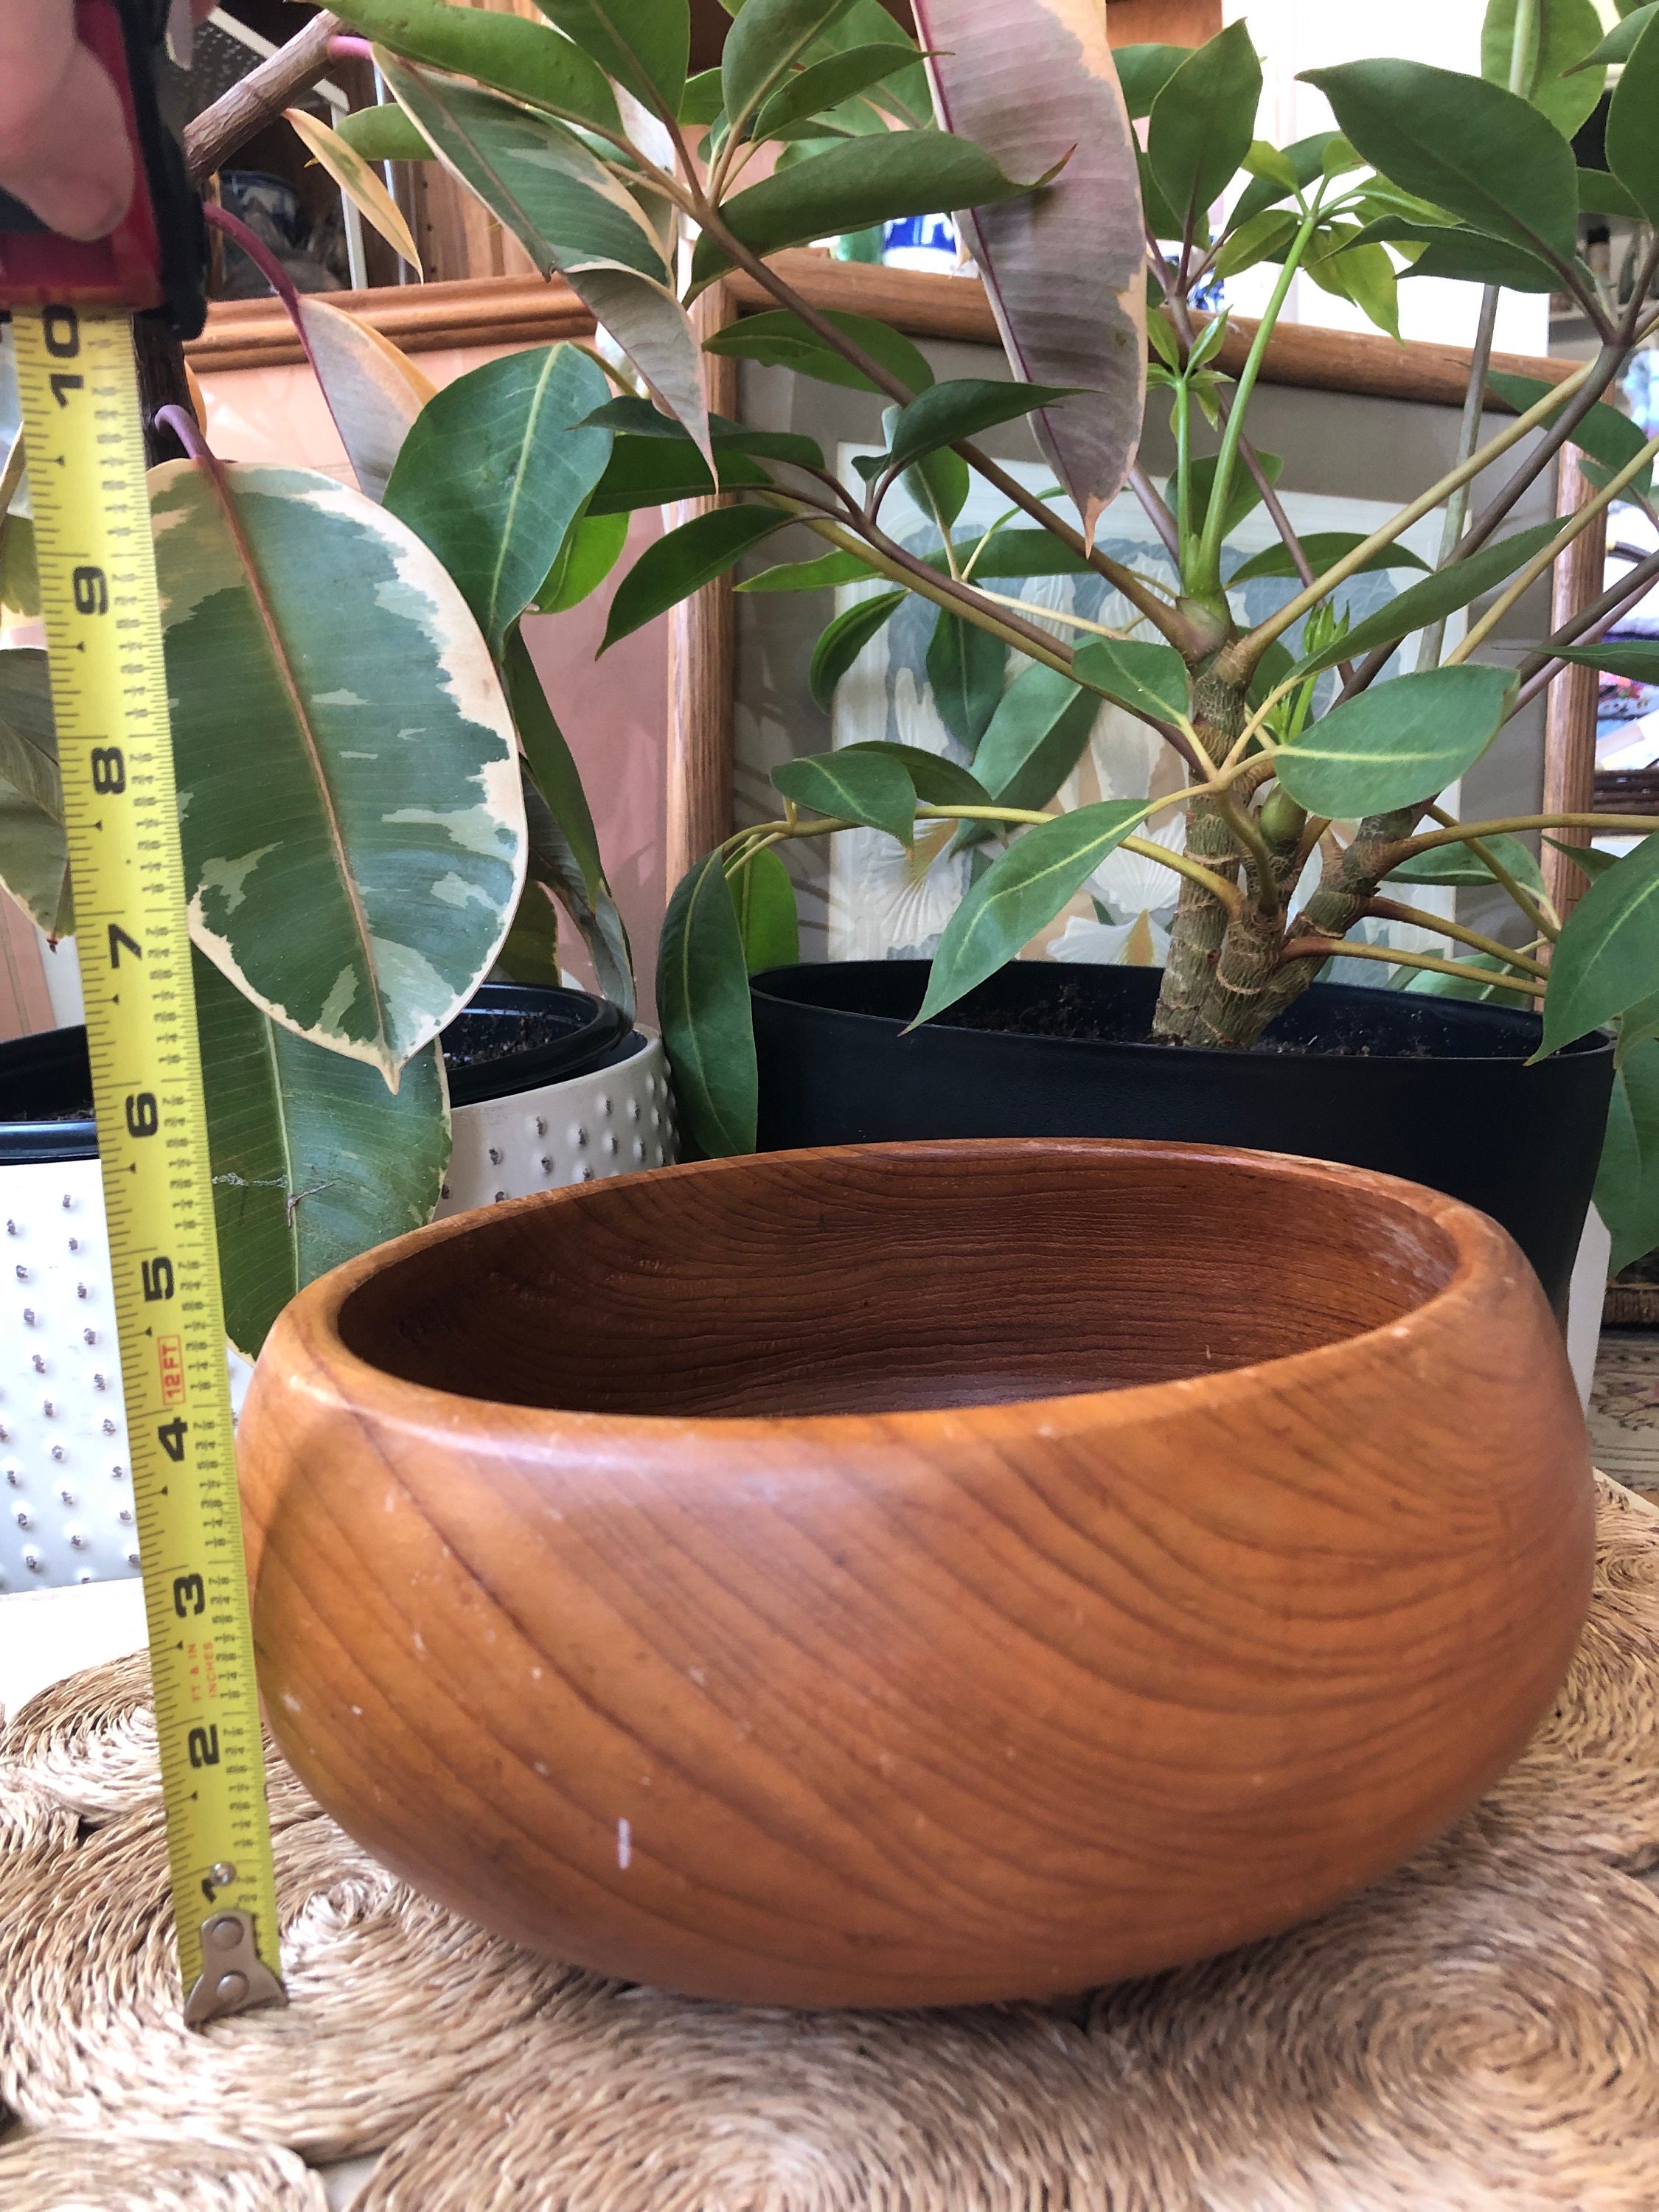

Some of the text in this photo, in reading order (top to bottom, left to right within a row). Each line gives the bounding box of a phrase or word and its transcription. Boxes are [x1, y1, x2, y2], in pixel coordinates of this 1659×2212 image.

[42, 304, 84, 408] 10
[72, 566, 108, 615] 9
[91, 746, 126, 795] 8
[108, 923, 142, 969] 7
[125, 1092, 159, 1138] 6
[141, 1256, 175, 1302] 5
[157, 1417, 189, 1462] 4
[173, 1573, 206, 1618] 3
[187, 1724, 220, 1769] 2
